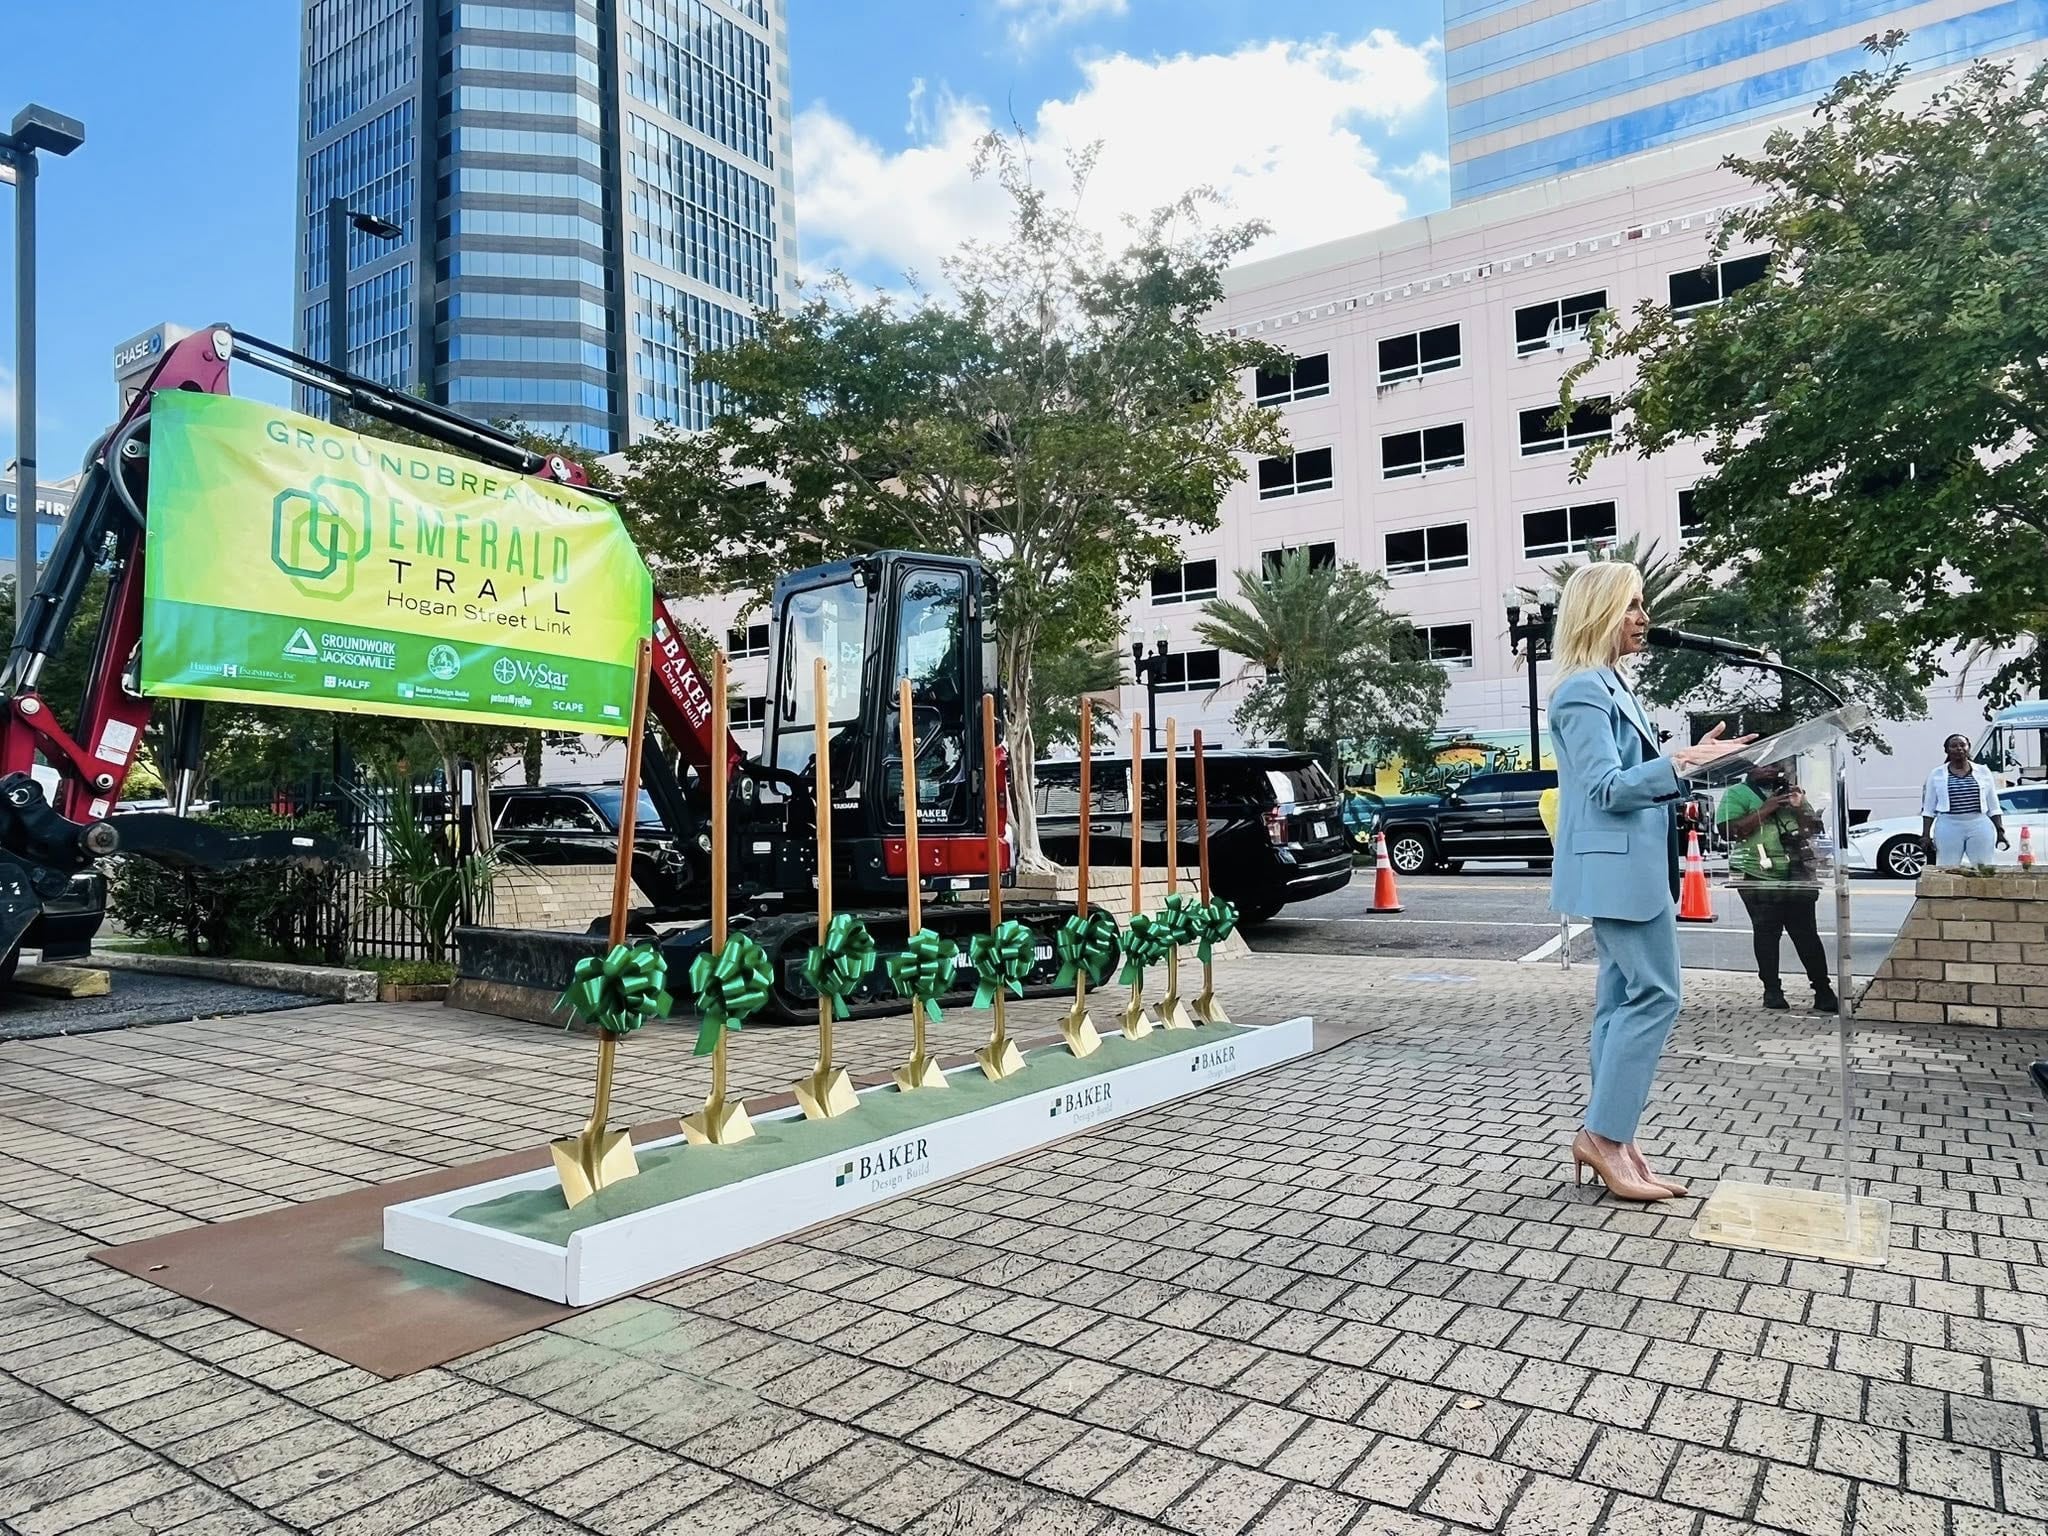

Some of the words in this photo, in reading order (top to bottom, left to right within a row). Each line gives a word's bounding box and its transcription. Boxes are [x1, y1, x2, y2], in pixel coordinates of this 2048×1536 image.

[115, 340, 149, 369] CHASE
[36, 499, 69, 517] FIR
[389, 498, 568, 584] EMERALD
[389, 559, 570, 614] TRAIL
[387, 590, 457, 616] Hogan
[464, 604, 527, 629] Street
[535, 616, 571, 636] Link
[321, 633, 396, 655] GROUNDWORK
[320, 651, 396, 670] JACKSONVILLE
[516, 660, 569, 686] VyStar
[338, 678, 371, 690] HALFF
[662, 638, 712, 720] BAKER
[552, 701, 584, 713] SCAPE
[662, 662, 684, 700] Design
[682, 699, 703, 728] Build
[917, 809, 946, 817] BAKER
[1202, 1046, 1235, 1069] BAKER
[1066, 1082, 1111, 1113] BAKER
[859, 1138, 928, 1180] BAKER
[871, 1175, 902, 1193] Design
[906, 1160, 929, 1180] Build
